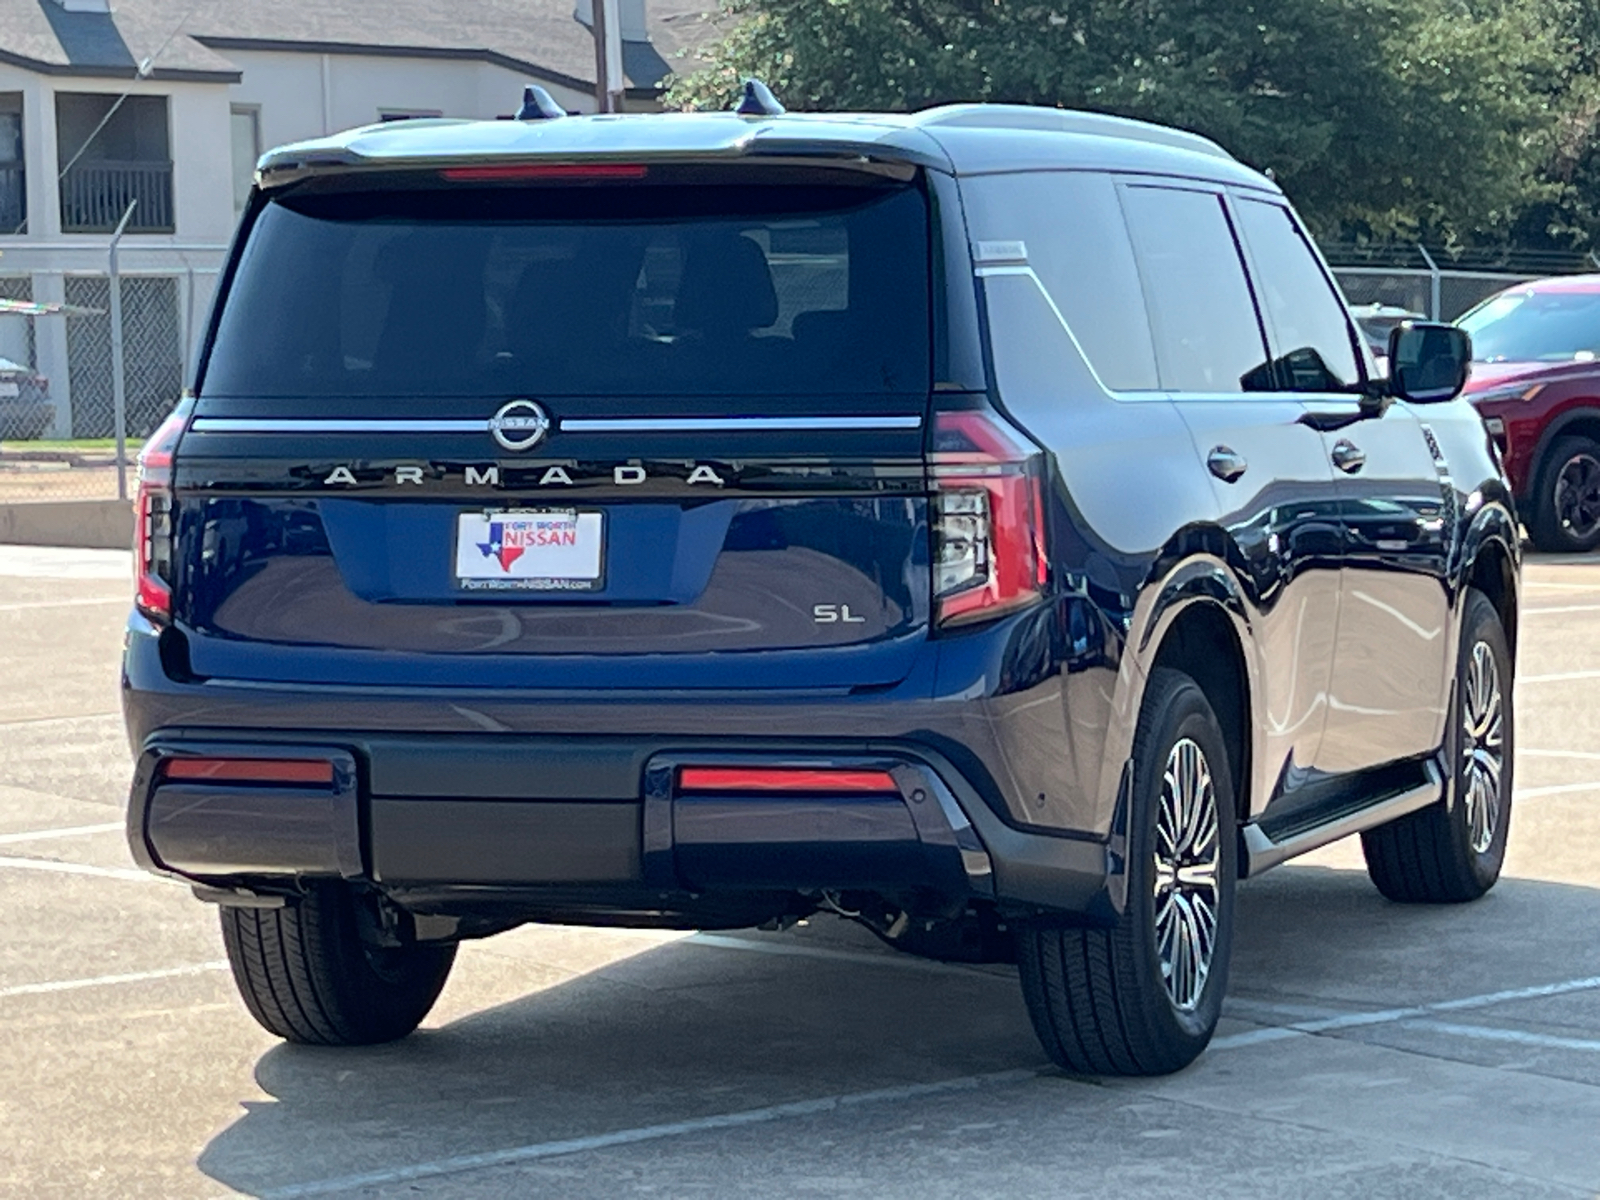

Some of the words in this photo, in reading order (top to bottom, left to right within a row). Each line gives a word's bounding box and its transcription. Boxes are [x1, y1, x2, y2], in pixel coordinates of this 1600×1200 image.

[489, 418, 550, 429] NISSAN
[323, 465, 725, 486] ARMADA
[505, 522, 532, 530] FORT
[537, 521, 576, 531] WORTH
[505, 531, 576, 546] NISSAN
[813, 604, 866, 623] SL
